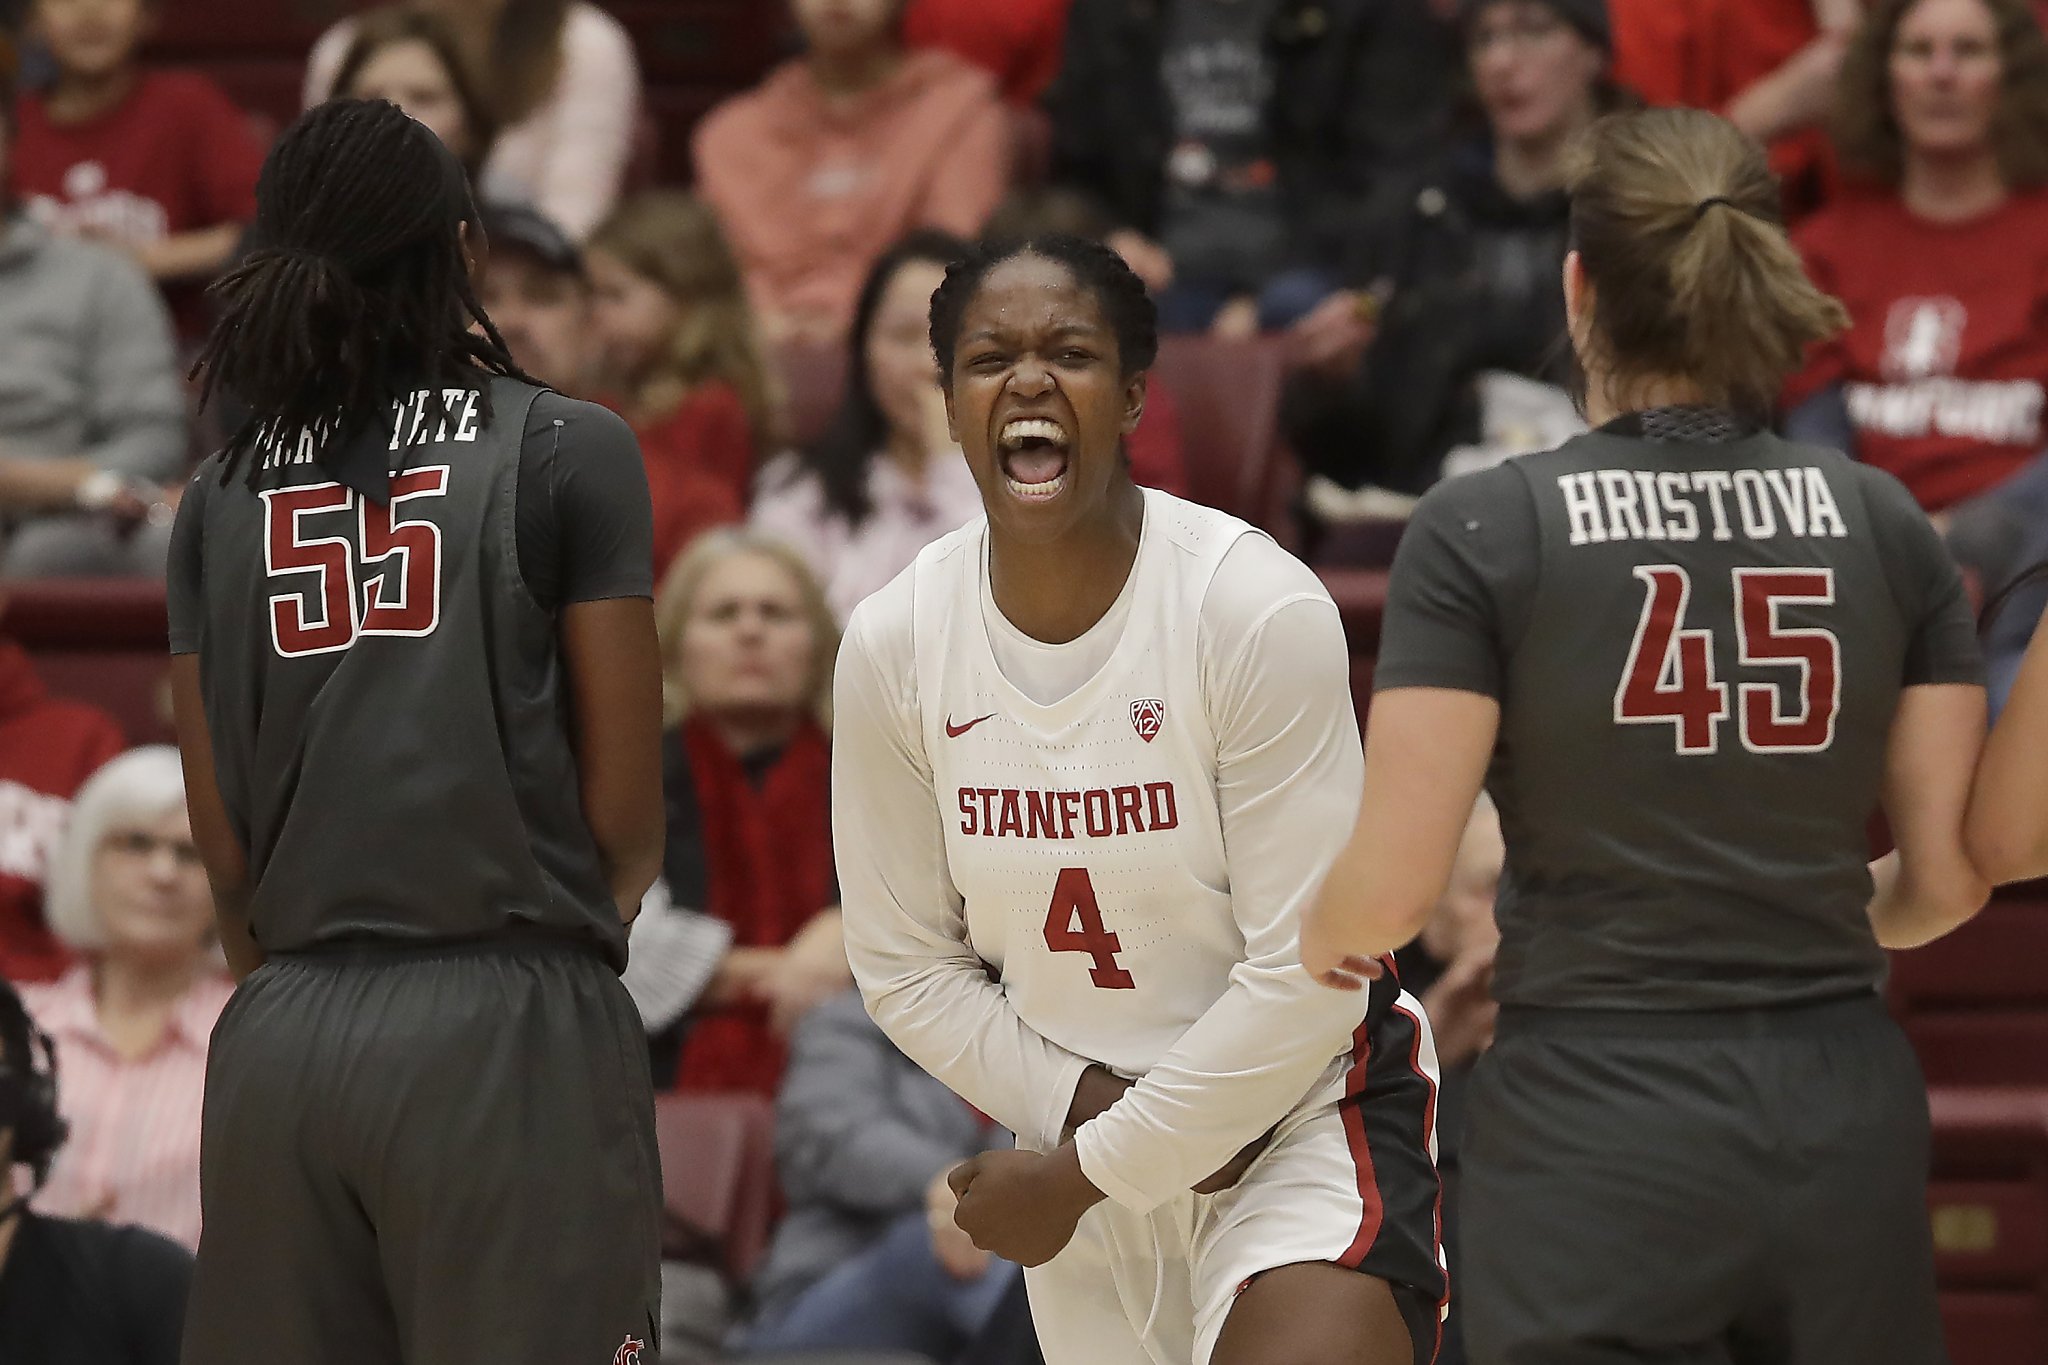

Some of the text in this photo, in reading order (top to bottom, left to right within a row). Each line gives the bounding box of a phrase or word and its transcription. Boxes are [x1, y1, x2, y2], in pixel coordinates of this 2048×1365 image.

[1557, 466, 1849, 545] HRISTOVA
[258, 464, 450, 658] 55
[1613, 564, 1842, 756] 45
[1131, 700, 1163, 726] PAC
[1139, 717, 1157, 735] 12
[957, 781, 1179, 839] STANFORD
[1043, 867, 1136, 990] 4
